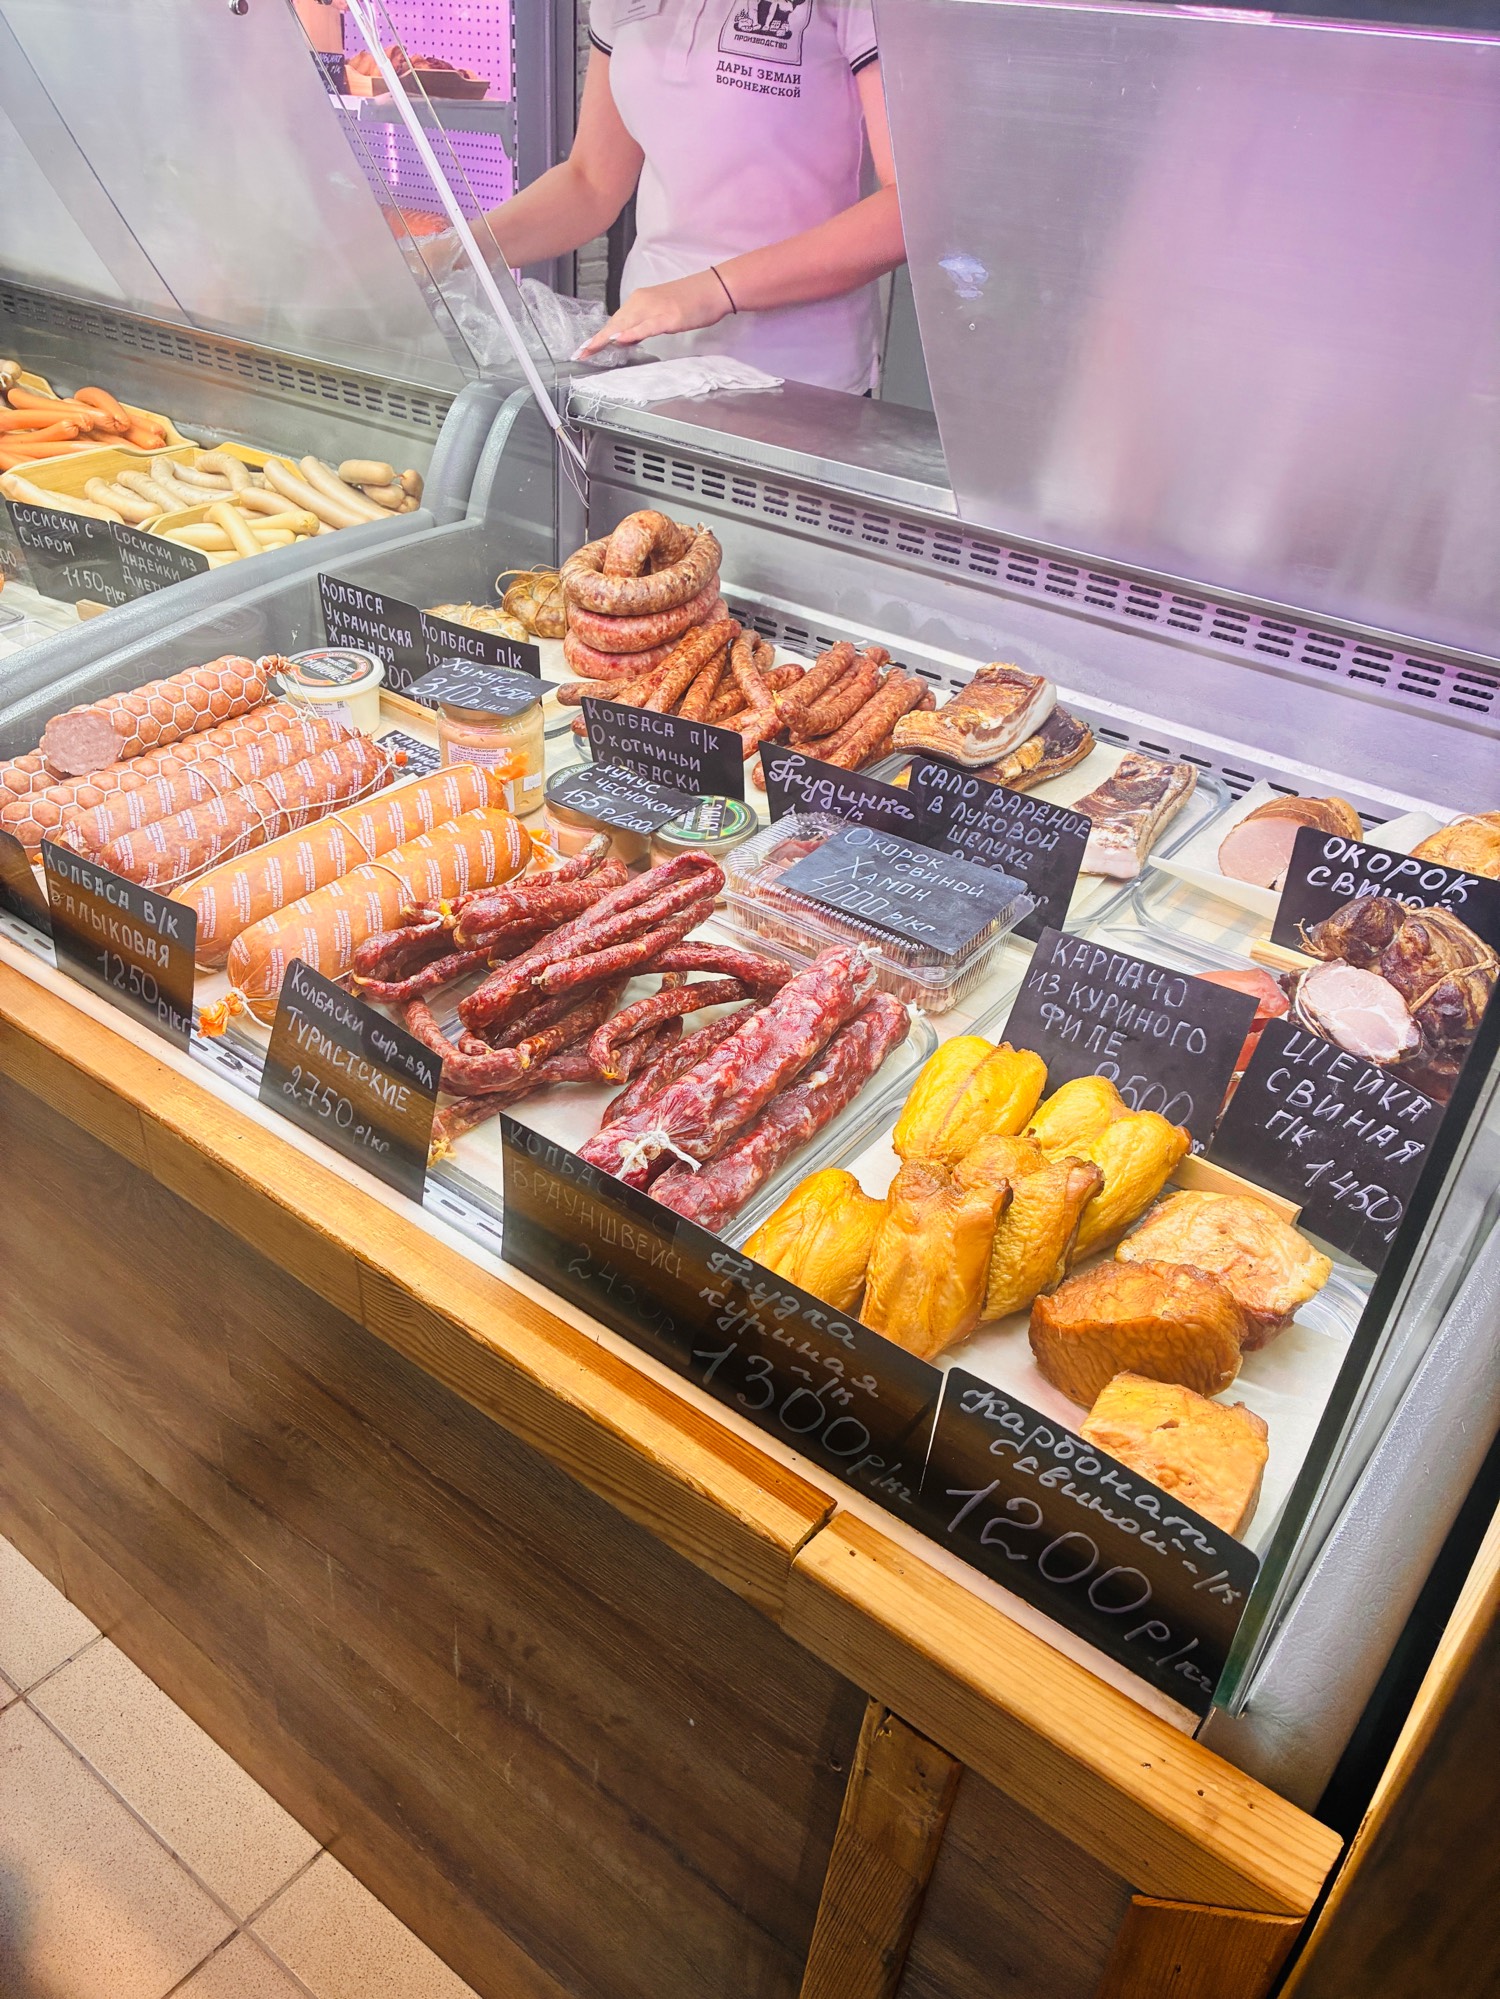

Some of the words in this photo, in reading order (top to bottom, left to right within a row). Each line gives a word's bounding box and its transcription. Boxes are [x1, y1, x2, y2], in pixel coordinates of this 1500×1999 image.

[716, 60, 753, 77] ДАРЫ
[757, 68, 801, 85] ЗЕМЛИ
[733, 34, 788, 50] ПРОИЗВОДСТВО
[716, 74, 801, 98] ВОРОНЕЖСКОЙ
[62, 566, 104, 592] 1150
[410, 677, 482, 702] 310
[578, 769, 590, 783] С
[595, 776, 682, 818] ЧЕСНОКОМ
[595, 763, 660, 796] ХУМУС
[768, 755, 915, 820] Грудинка
[917, 764, 979, 799] САЛО
[985, 788, 1091, 840] ВАРЁНОЕ
[697, 802, 724, 833] ХУМУС
[927, 795, 944, 813] В
[950, 801, 1060, 851] ЛУКОВОЙ
[947, 824, 1034, 870] ШЕЛУХЕ
[808, 873, 890, 916] 4000
[1322, 836, 1479, 904] ОКОРОК
[96, 949, 159, 1004] 1250
[1050, 938, 1188, 1008] КАРПАЧО
[1027, 968, 1060, 996] ИЗ
[1066, 980, 1208, 1054] КУРИНОГО
[1039, 1001, 1128, 1057] ФИЛЕ
[286, 1004, 411, 1113] ТУРИСТСКИЕ
[1282, 1030, 1432, 1123] ШЕЙКА
[282, 1064, 354, 1128] 2750
[1266, 1067, 1426, 1164] СВИНАЯ
[510, 1158, 682, 1280] БРАУНШВЕЙС
[706, 1251, 857, 1350] Грудка
[698, 1287, 880, 1398] куриная
[693, 1342, 871, 1456] 1300
[962, 1388, 1218, 1556] Карбонат
[945, 1479, 1152, 1614] 1200
